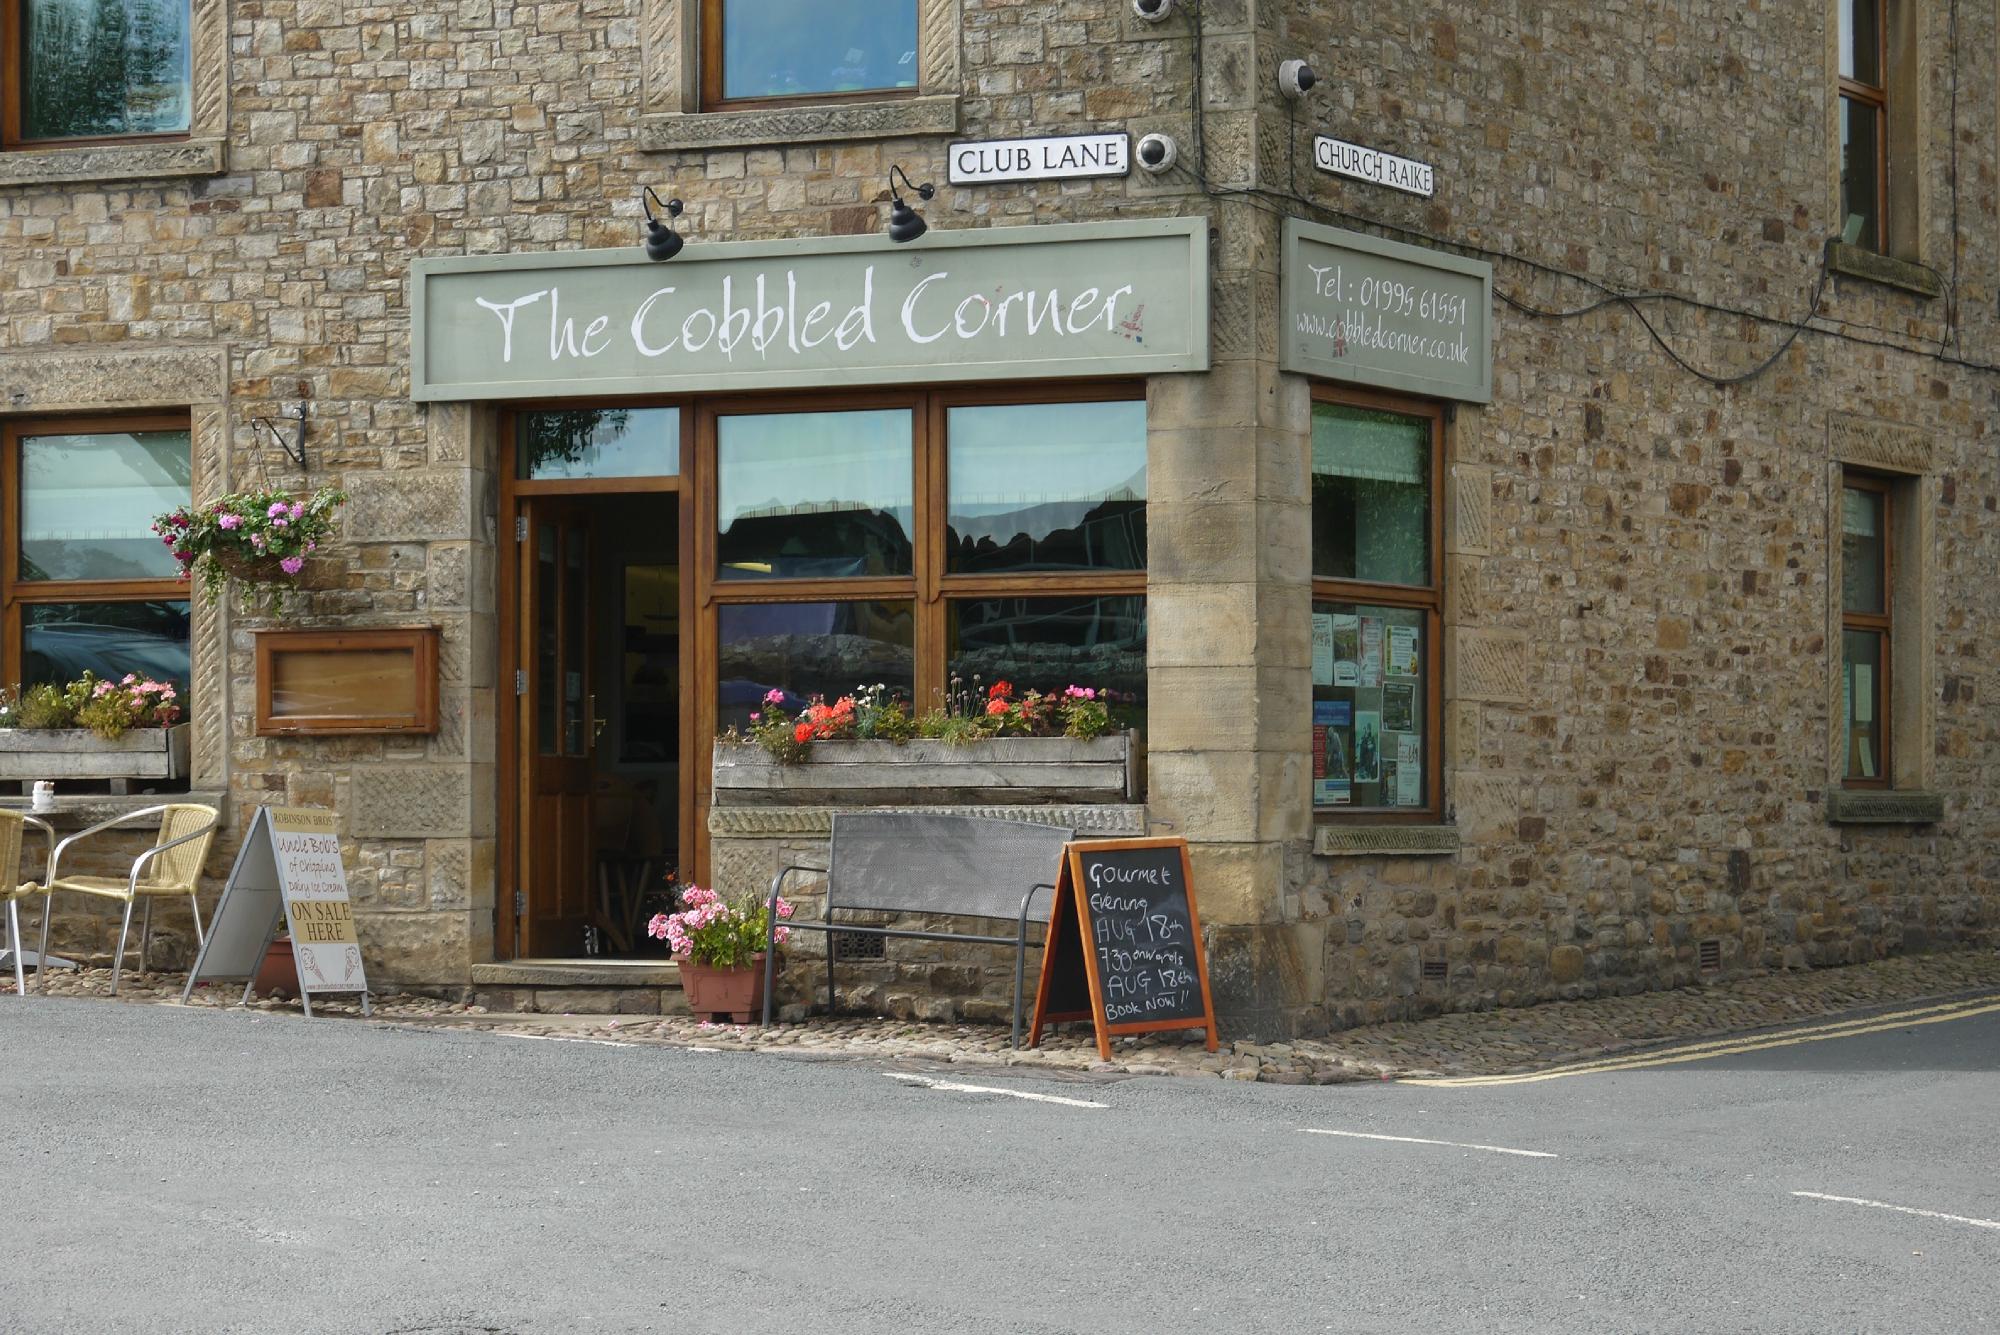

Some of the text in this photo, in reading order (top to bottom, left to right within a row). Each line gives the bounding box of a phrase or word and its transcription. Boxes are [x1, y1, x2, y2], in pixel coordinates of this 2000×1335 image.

[958, 143, 1118, 174] CLUB LANE
[1318, 141, 1431, 191] CHURCH RAIKE
[475, 265, 1133, 363] The Cobbled Corner
[1360, 276, 1414, 316] 01995
[1419, 289, 1466, 325] 61551
[1296, 309, 1469, 365] www.cobbledcorner.co.uk
[273, 812, 333, 826] ROBINSON BROS
[276, 834, 339, 854] Uncle Bob's
[289, 856, 337, 879] of Chipping
[1090, 863, 1171, 889] Gourmet
[291, 902, 352, 921] ON SALE
[1090, 892, 1148, 927] Evening
[306, 922, 345, 941] HERE
[1096, 917, 1136, 945] AUG
[1107, 968, 1193, 998] AUG 18th
